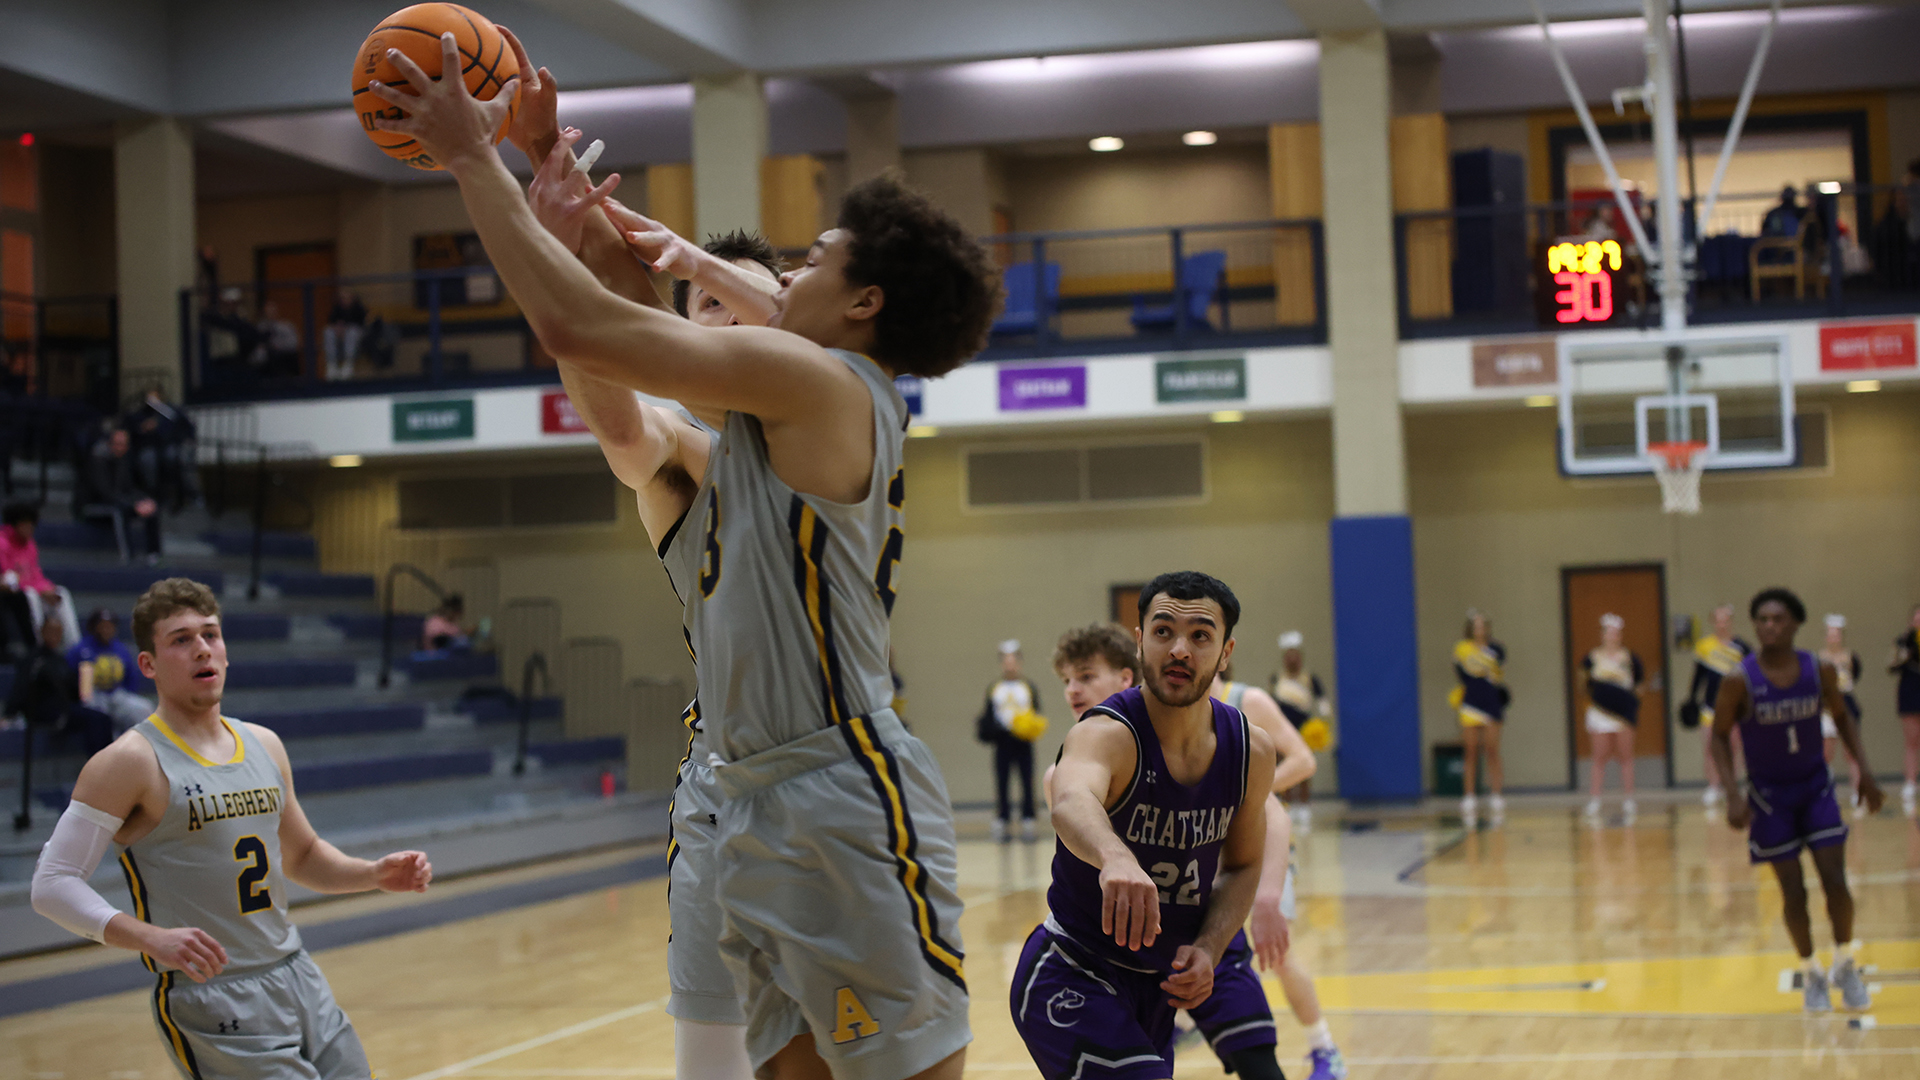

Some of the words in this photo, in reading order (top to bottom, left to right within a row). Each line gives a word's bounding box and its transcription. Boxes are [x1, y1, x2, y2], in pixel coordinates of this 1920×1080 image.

[1548, 239, 1622, 274] 19:27
[1554, 270, 1613, 323] 30
[1787, 725, 1799, 754] 1
[1126, 803, 1235, 850] CHATHAM
[232, 834, 274, 915] 2
[1150, 859, 1201, 906] 22
[830, 985, 881, 1045] A
